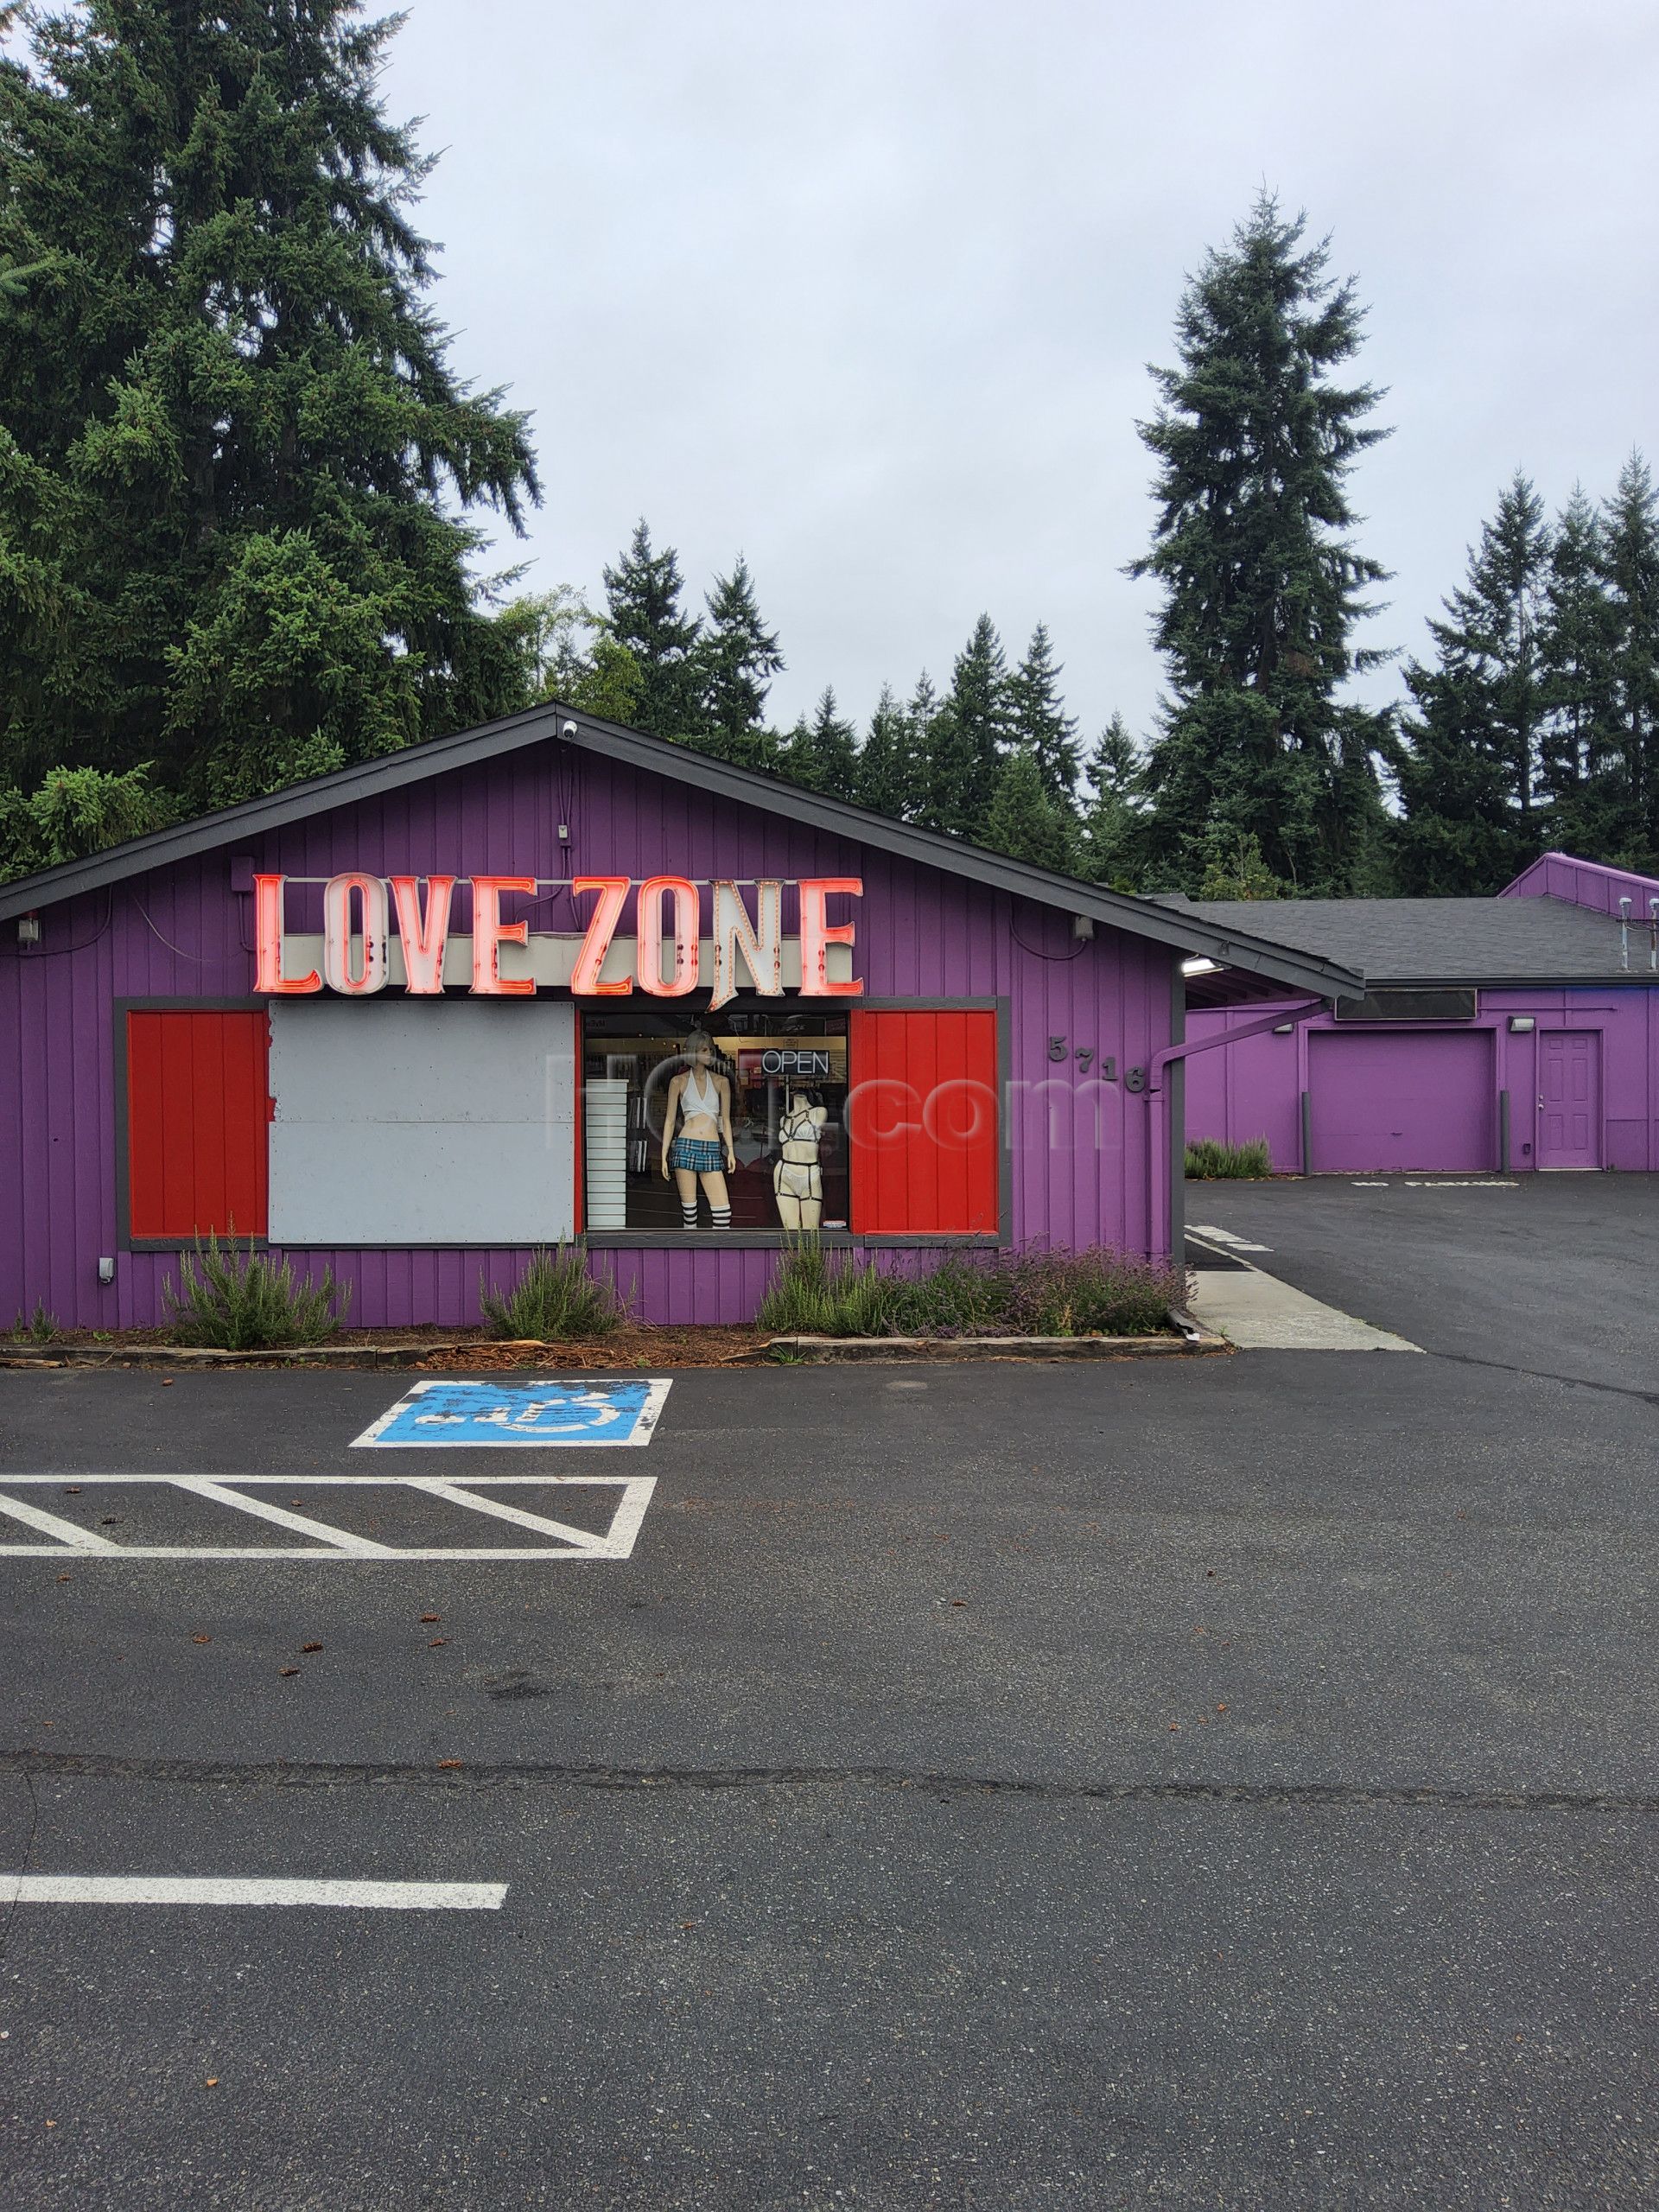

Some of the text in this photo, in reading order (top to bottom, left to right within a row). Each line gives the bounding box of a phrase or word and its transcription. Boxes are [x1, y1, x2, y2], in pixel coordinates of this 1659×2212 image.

[252, 872, 864, 1014] LOVE ZONE
[762, 1050, 829, 1074] OPEN
[1048, 1036, 1147, 1093] 5716
